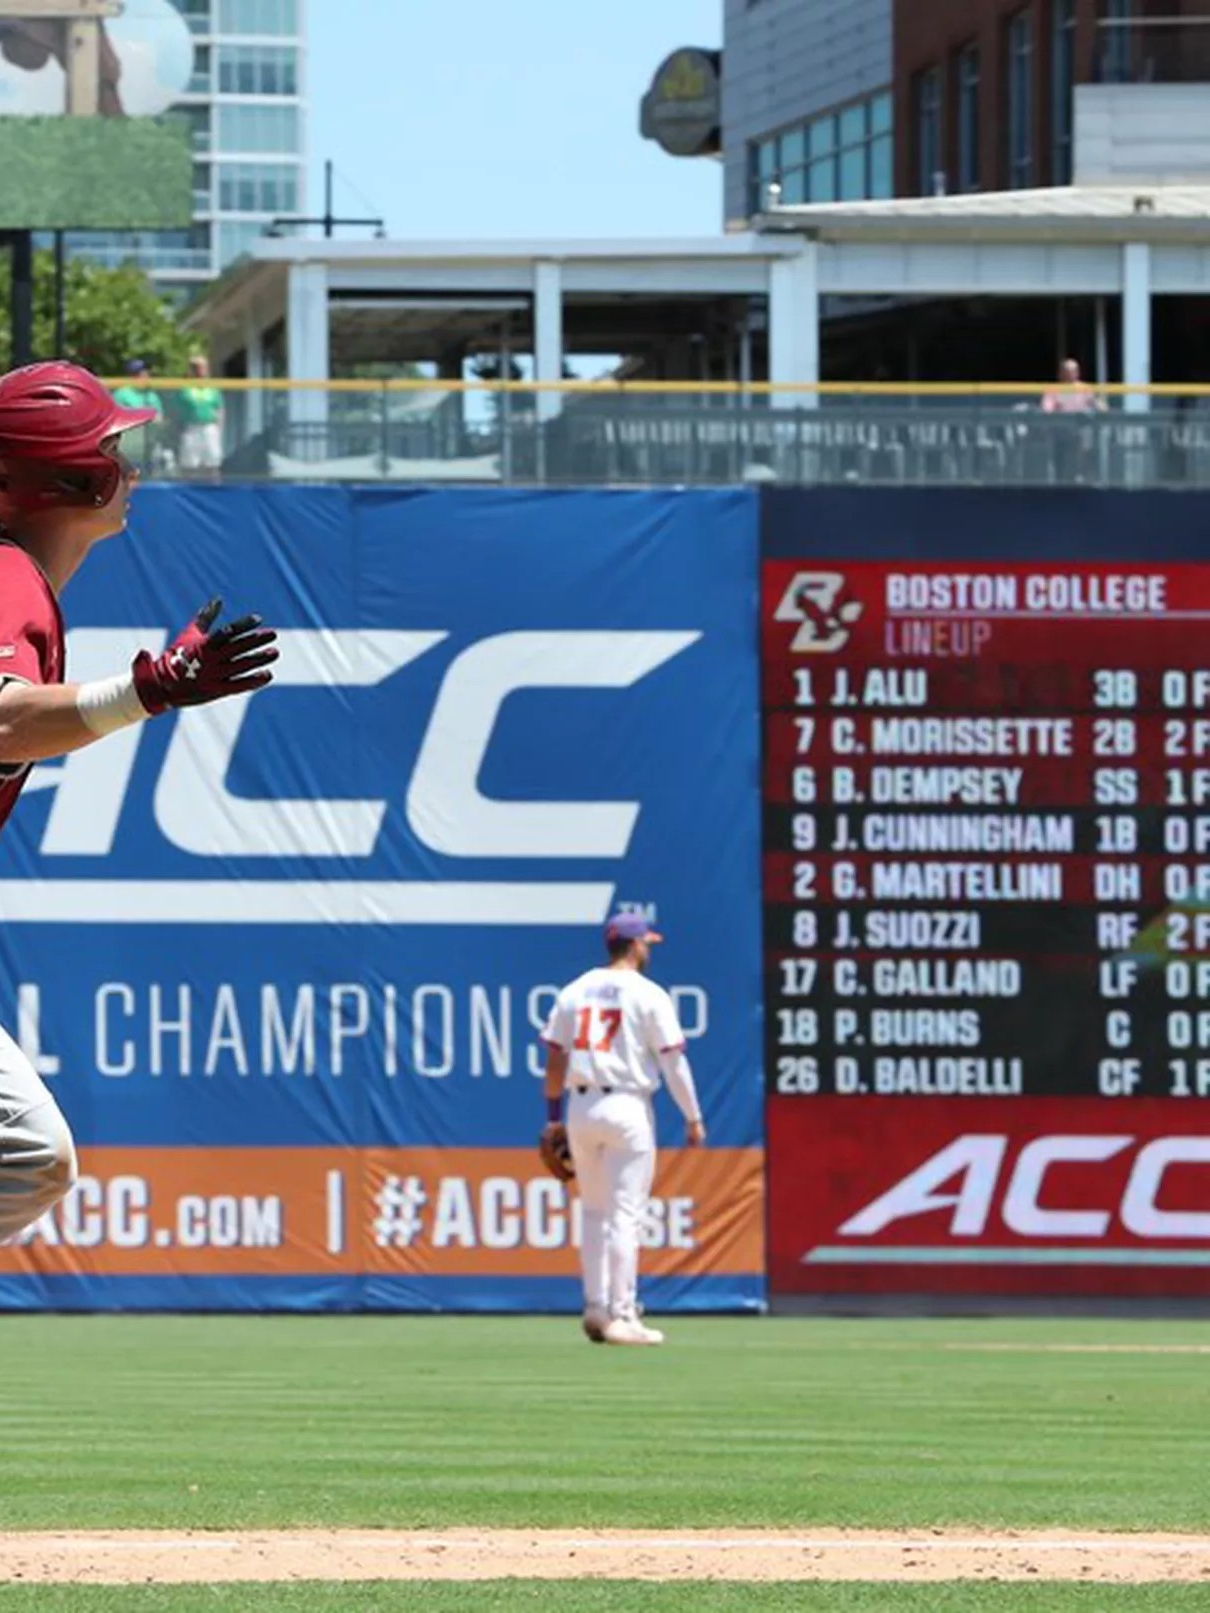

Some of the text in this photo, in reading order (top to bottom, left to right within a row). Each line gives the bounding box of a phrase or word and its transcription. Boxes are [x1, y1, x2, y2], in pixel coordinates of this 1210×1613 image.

[887, 574, 1166, 610] BOSTON COLLEGE
[885, 621, 991, 656] LINEUP
[794, 669, 815, 705] 1
[863, 669, 927, 706] ALU
[1094, 670, 1137, 707] 3B
[1163, 671, 1186, 707] 0
[794, 718, 815, 753] 7
[871, 718, 1072, 755] MORISSETTE
[1093, 719, 1136, 756] 2B
[1164, 720, 1186, 756] 2
[793, 767, 816, 803] 6
[871, 767, 1023, 804] DEMPSEY
[1094, 768, 1138, 805] SS
[1165, 769, 1187, 805] 1
[793, 814, 816, 851] 9
[863, 815, 1073, 852] CUNNINGHAM
[1096, 816, 1137, 853] 1B
[1164, 816, 1188, 853] 0
[794, 862, 816, 899] 2
[872, 863, 1062, 900] MARTELLINI
[1094, 863, 1140, 900] DH
[1165, 864, 1188, 901] 0
[793, 911, 817, 948] 8
[865, 912, 980, 949] SUOZZI
[1097, 913, 1137, 950] RF
[1166, 912, 1189, 950] 2
[780, 959, 817, 995] 17
[873, 960, 1021, 997] GALLAND
[1100, 960, 1137, 997] LF
[1166, 961, 1190, 998] 0
[95, 982, 708, 1078] CHAMPIONSP
[573, 1006, 622, 1052] 17
[777, 1009, 818, 1045] 18
[871, 1010, 980, 1046] BURNS
[1107, 1011, 1131, 1048] C
[1167, 1011, 1192, 1048] 0
[777, 1057, 819, 1094] 26
[874, 1058, 1022, 1095] BALDELLI
[1099, 1059, 1141, 1096] CF
[1169, 1060, 1190, 1096] 1
[836, 1134, 1210, 1237] ACC
[12, 1175, 281, 1247] CC.COM
[374, 1176, 695, 1249] #ACCSE
